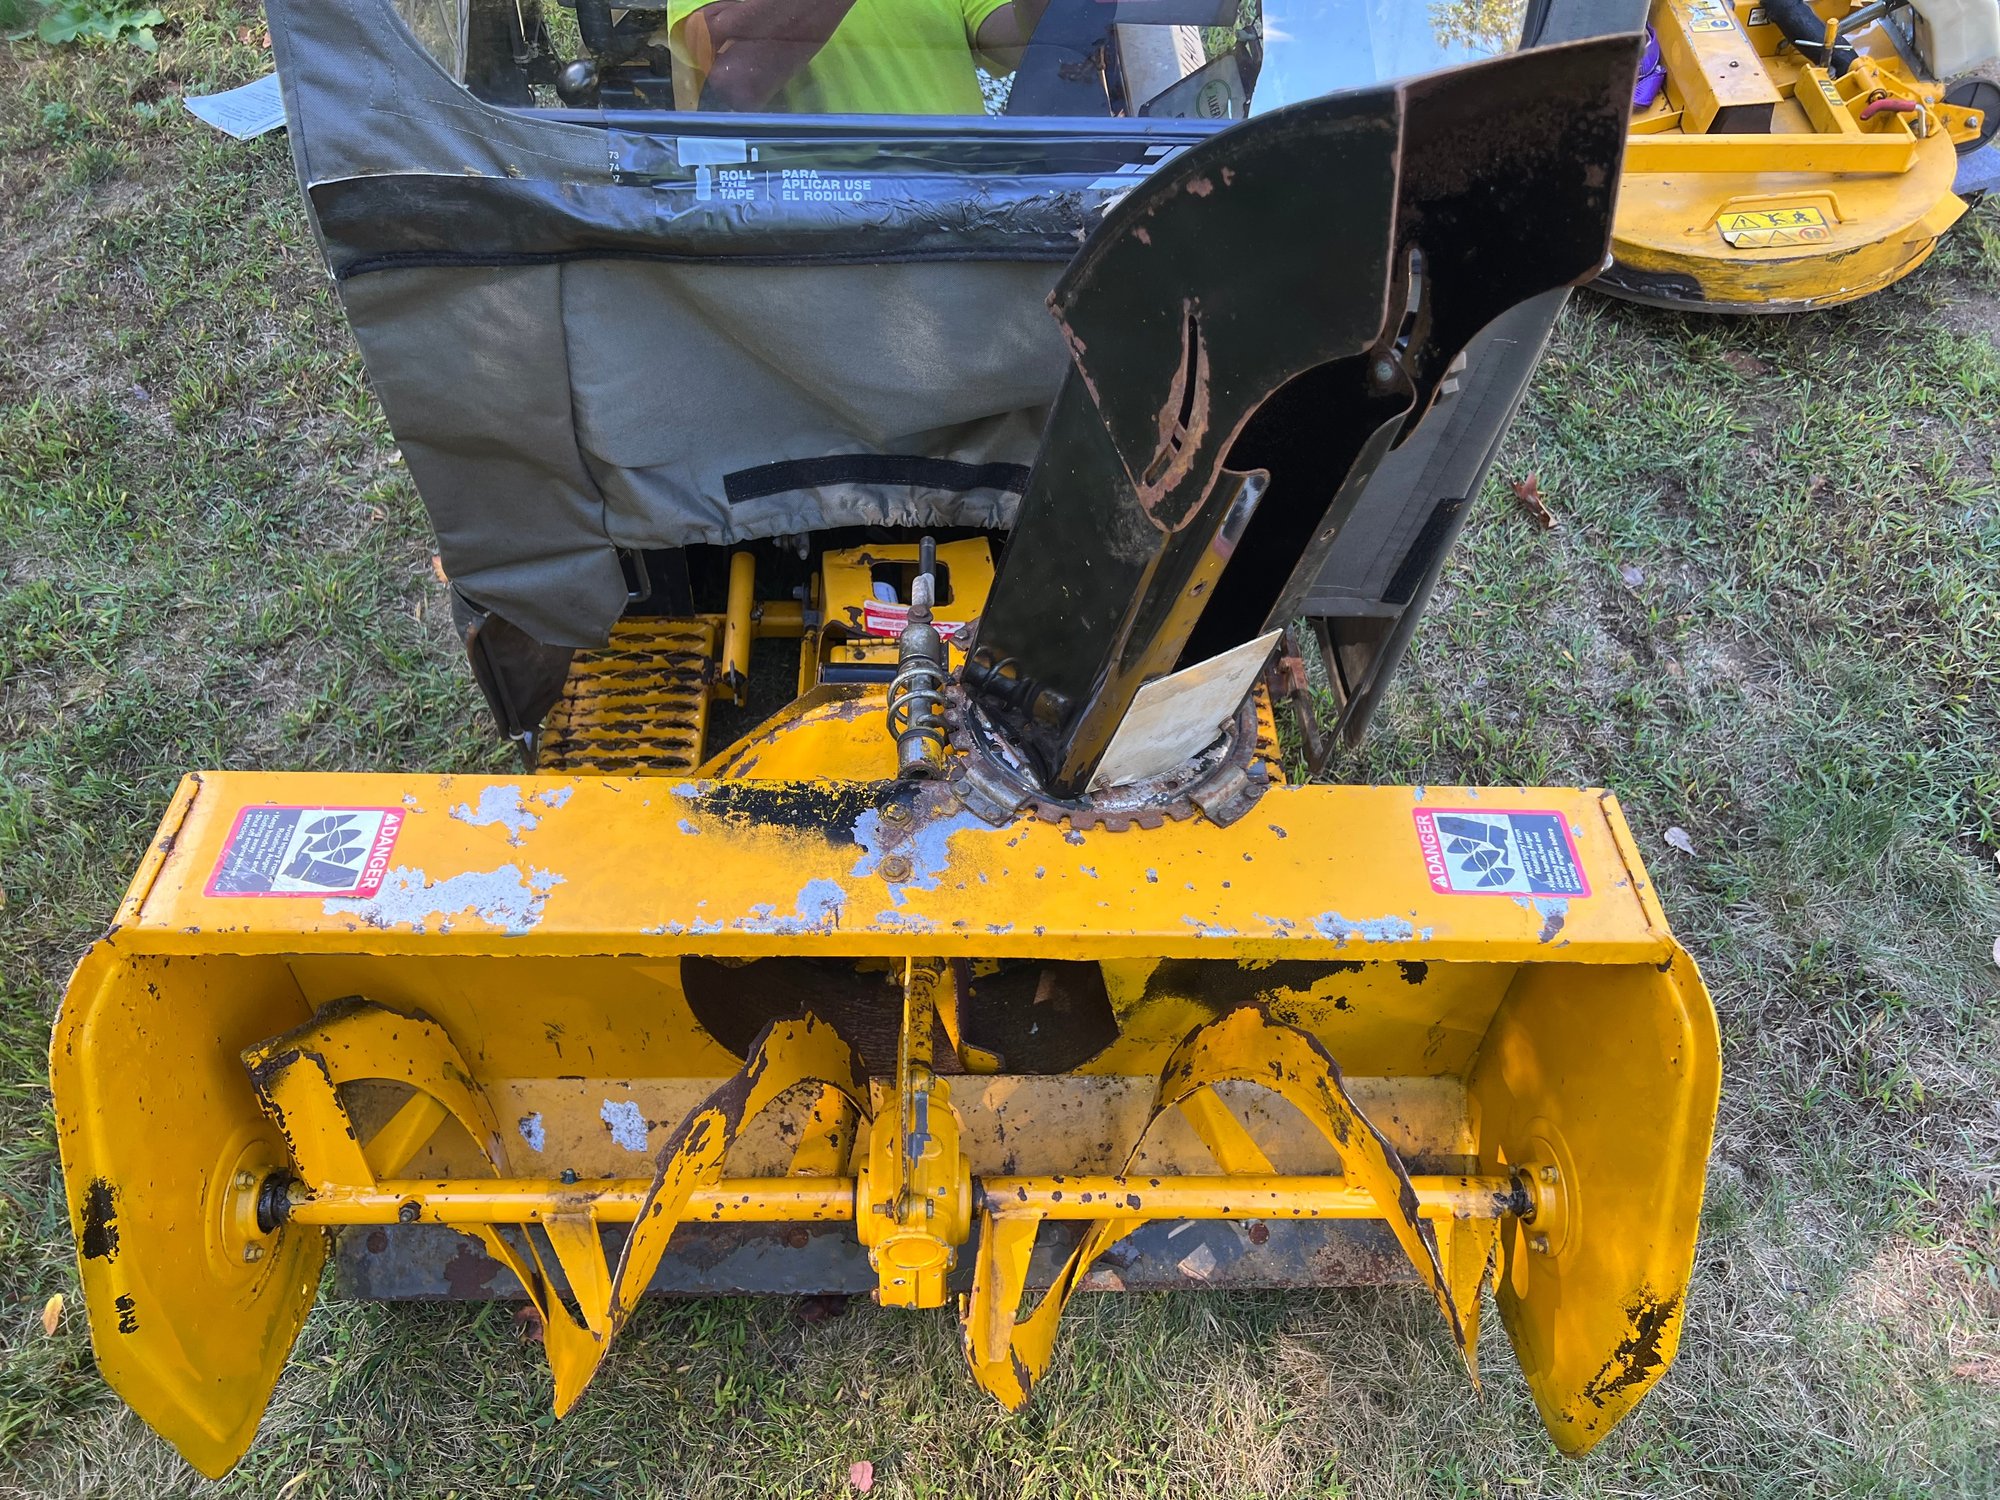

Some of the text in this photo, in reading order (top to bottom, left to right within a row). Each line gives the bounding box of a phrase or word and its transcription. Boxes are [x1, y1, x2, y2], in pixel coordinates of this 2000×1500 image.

[609, 151, 619, 160] 73
[609, 163, 619, 171] 74
[719, 170, 755, 181] ROLL
[782, 169, 819, 179] PARA
[782, 179, 872, 190] APLICAR USE
[719, 188, 755, 200] TAPE
[782, 190, 863, 201] EL RODILLO
[1416, 815, 1444, 875] DANGER
[361, 826, 398, 888] DANGER
